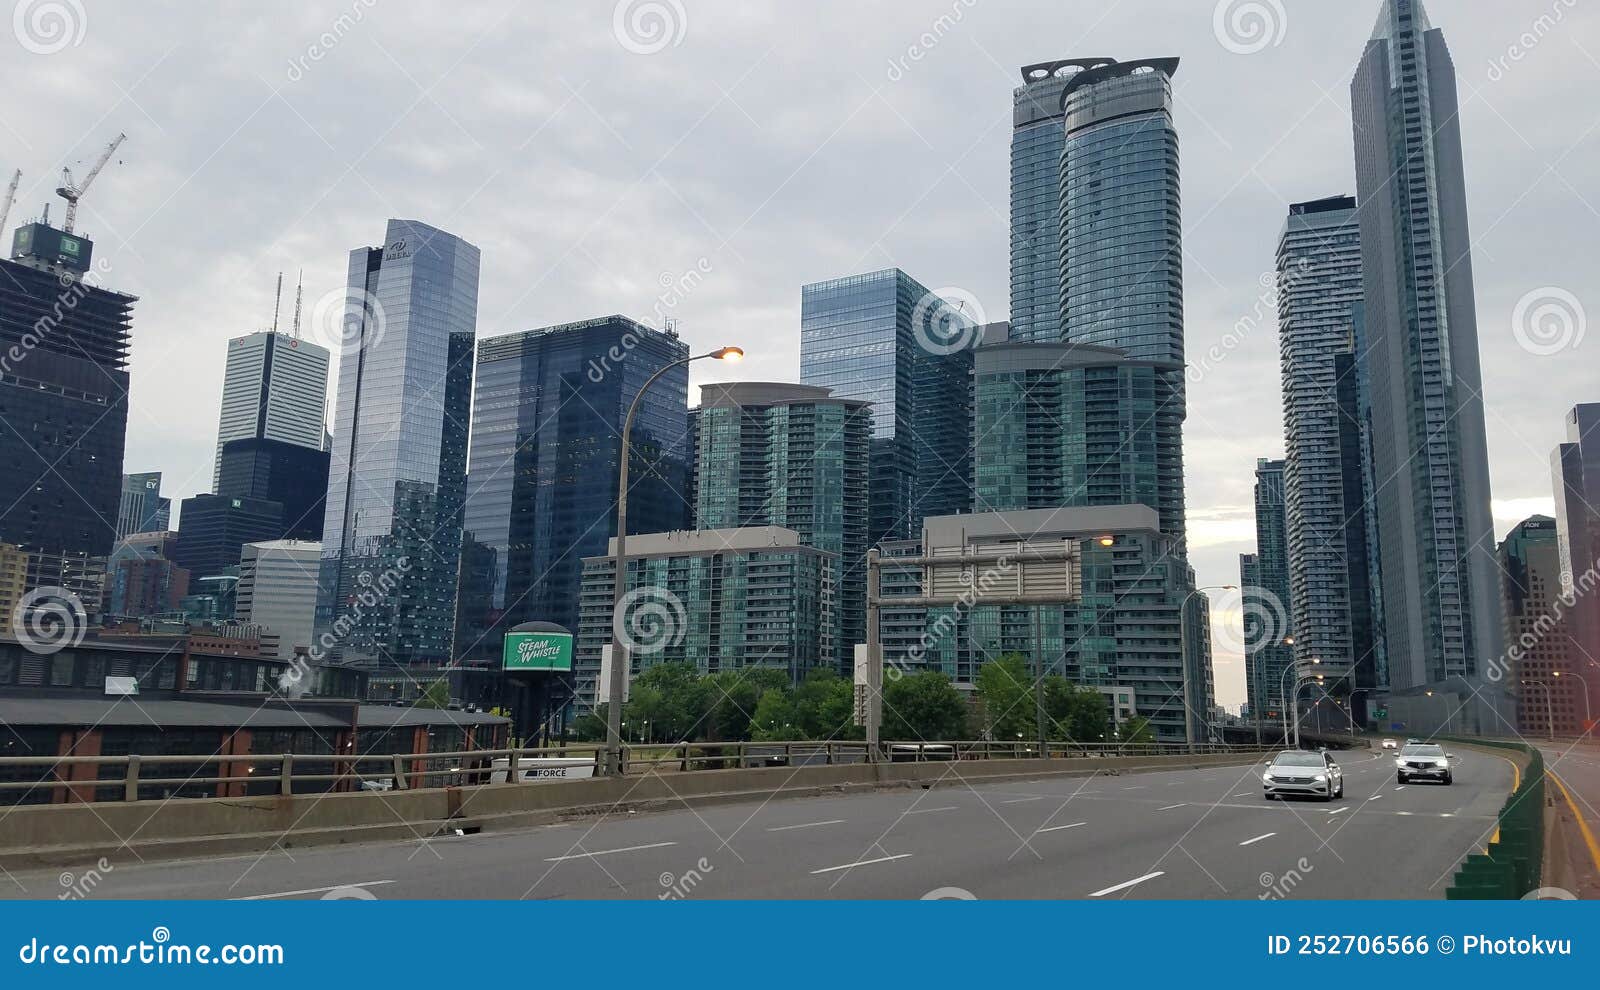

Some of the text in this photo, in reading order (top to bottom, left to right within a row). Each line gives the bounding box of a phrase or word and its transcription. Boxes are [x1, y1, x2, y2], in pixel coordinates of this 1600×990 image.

[146, 481, 157, 489] EY
[517, 640, 549, 653] STEAM
[521, 645, 560, 663] WHISTLE
[538, 769, 567, 777] FORCE
